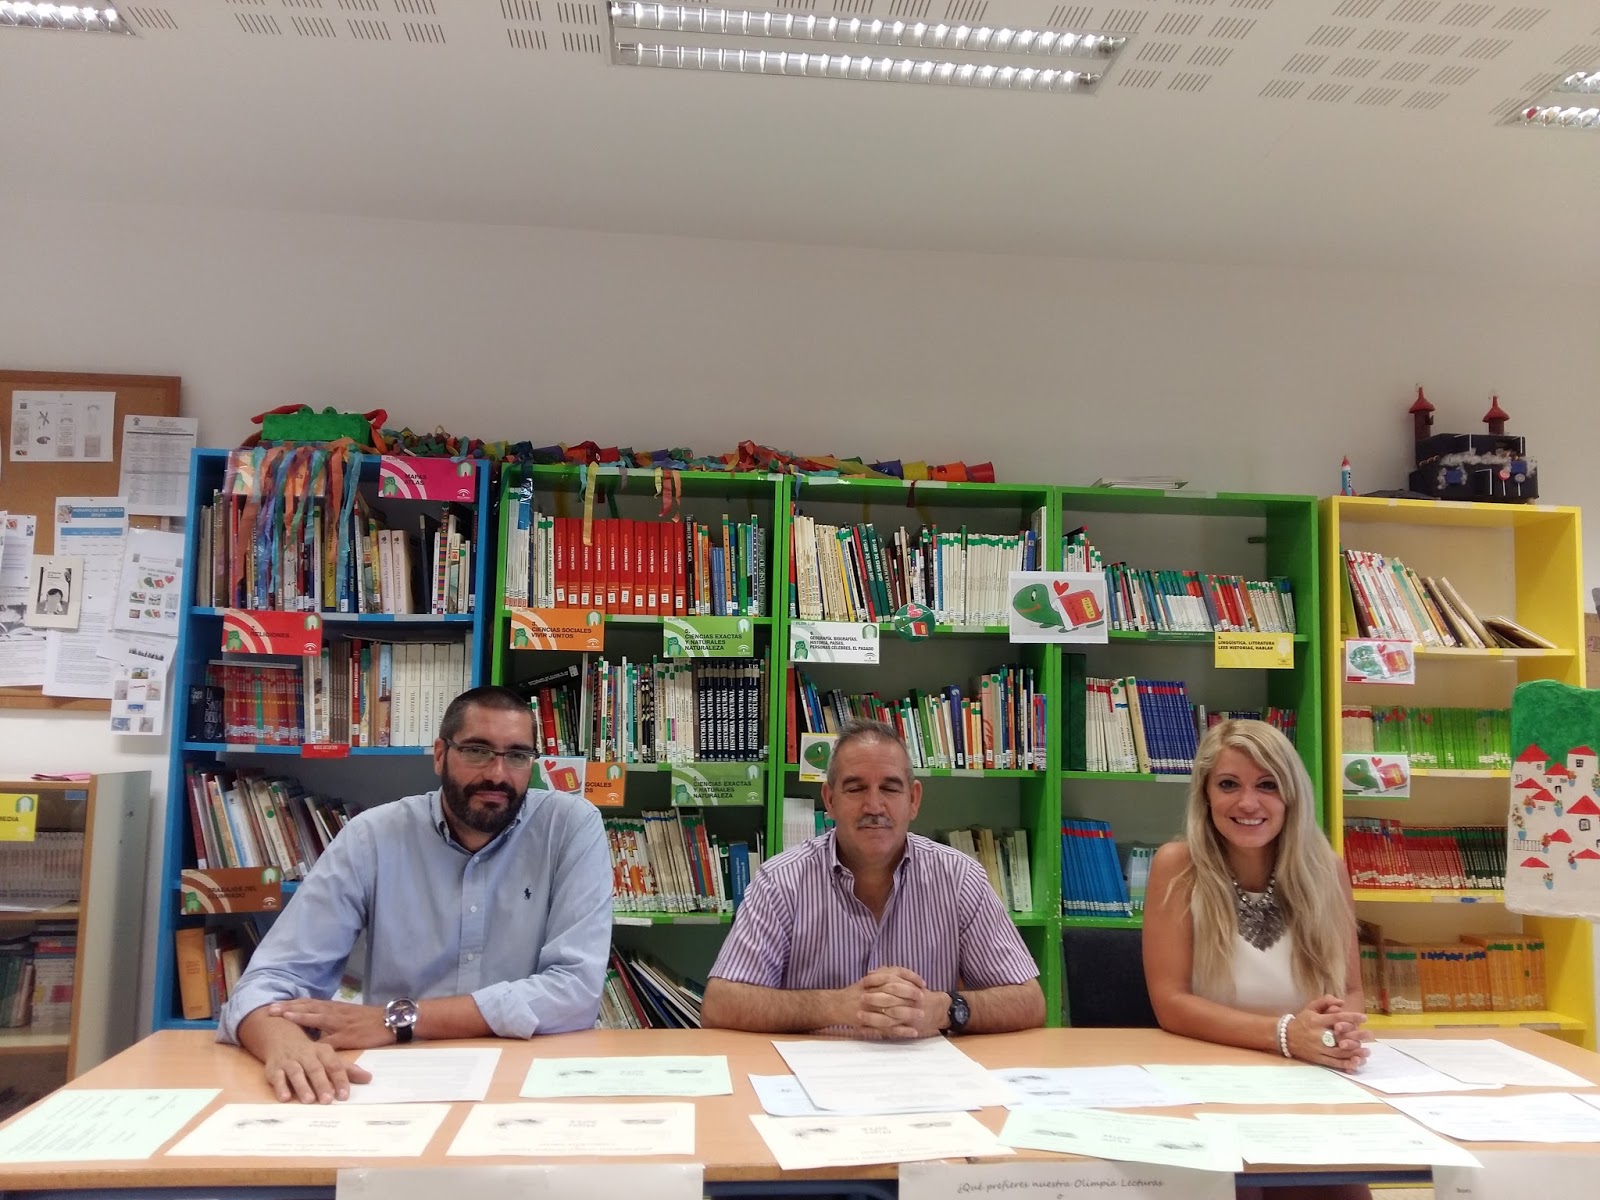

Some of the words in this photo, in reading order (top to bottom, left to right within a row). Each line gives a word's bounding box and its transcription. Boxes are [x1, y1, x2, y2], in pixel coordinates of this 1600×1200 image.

[957, 1182, 983, 1194] ¿Qué
[986, 1179, 1029, 1193] prefieres
[1032, 1180, 1071, 1189] nuestra
[1074, 1178, 1117, 1191] Olimpia
[1121, 1178, 1164, 1188] Lecturas
